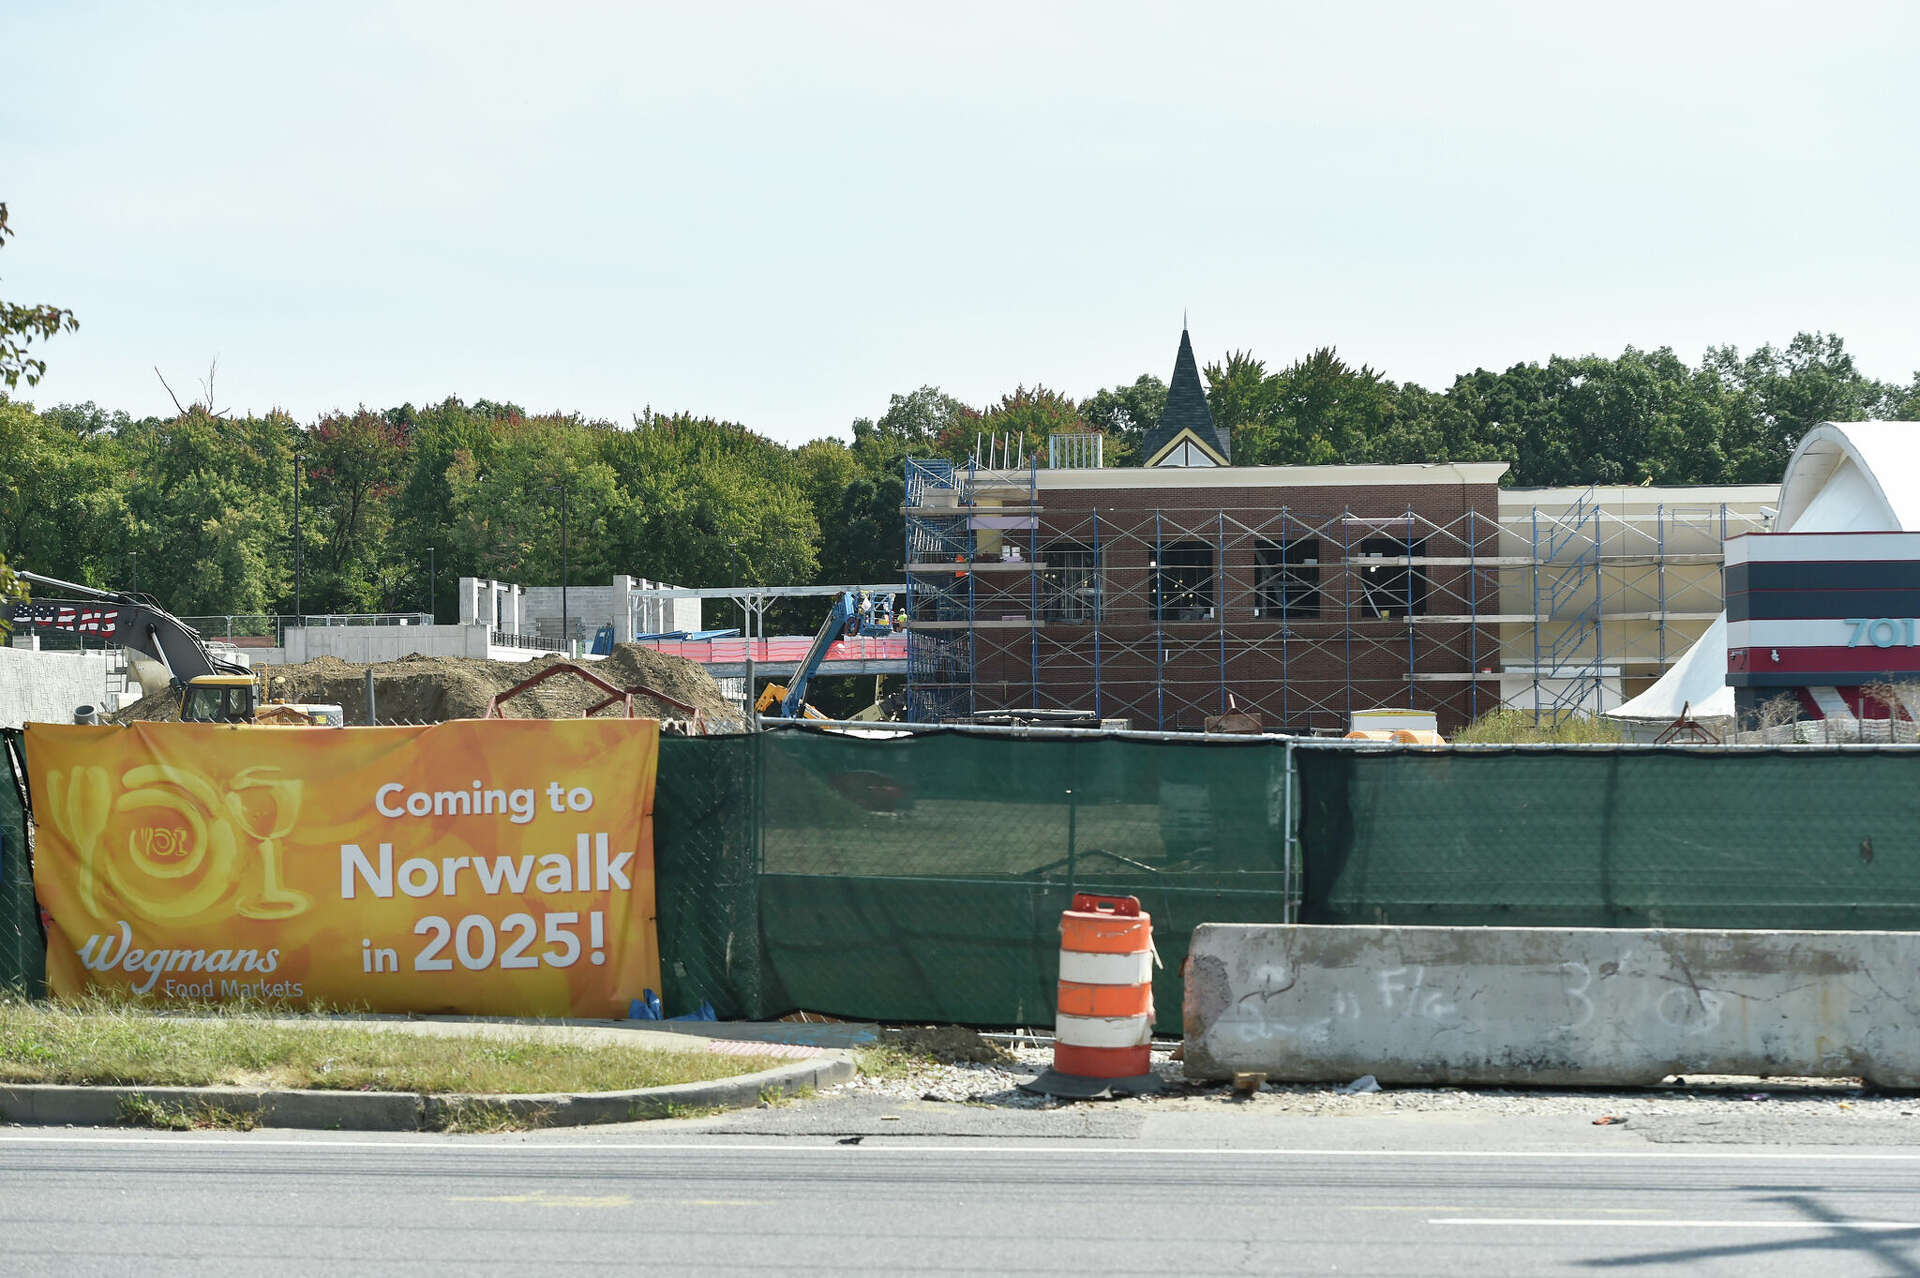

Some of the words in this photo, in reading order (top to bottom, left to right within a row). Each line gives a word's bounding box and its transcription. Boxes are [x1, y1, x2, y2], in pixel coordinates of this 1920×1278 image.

[13, 601, 119, 638] BURNS
[1844, 618, 1914, 648] 701
[375, 780, 535, 824] Coming
[546, 781, 594, 812] to
[340, 832, 635, 899] Norwalk
[77, 920, 280, 994] Wegmans
[361, 938, 399, 973] in
[413, 911, 607, 971] 2025!
[165, 979, 214, 998] Food
[220, 979, 304, 998] Markets
